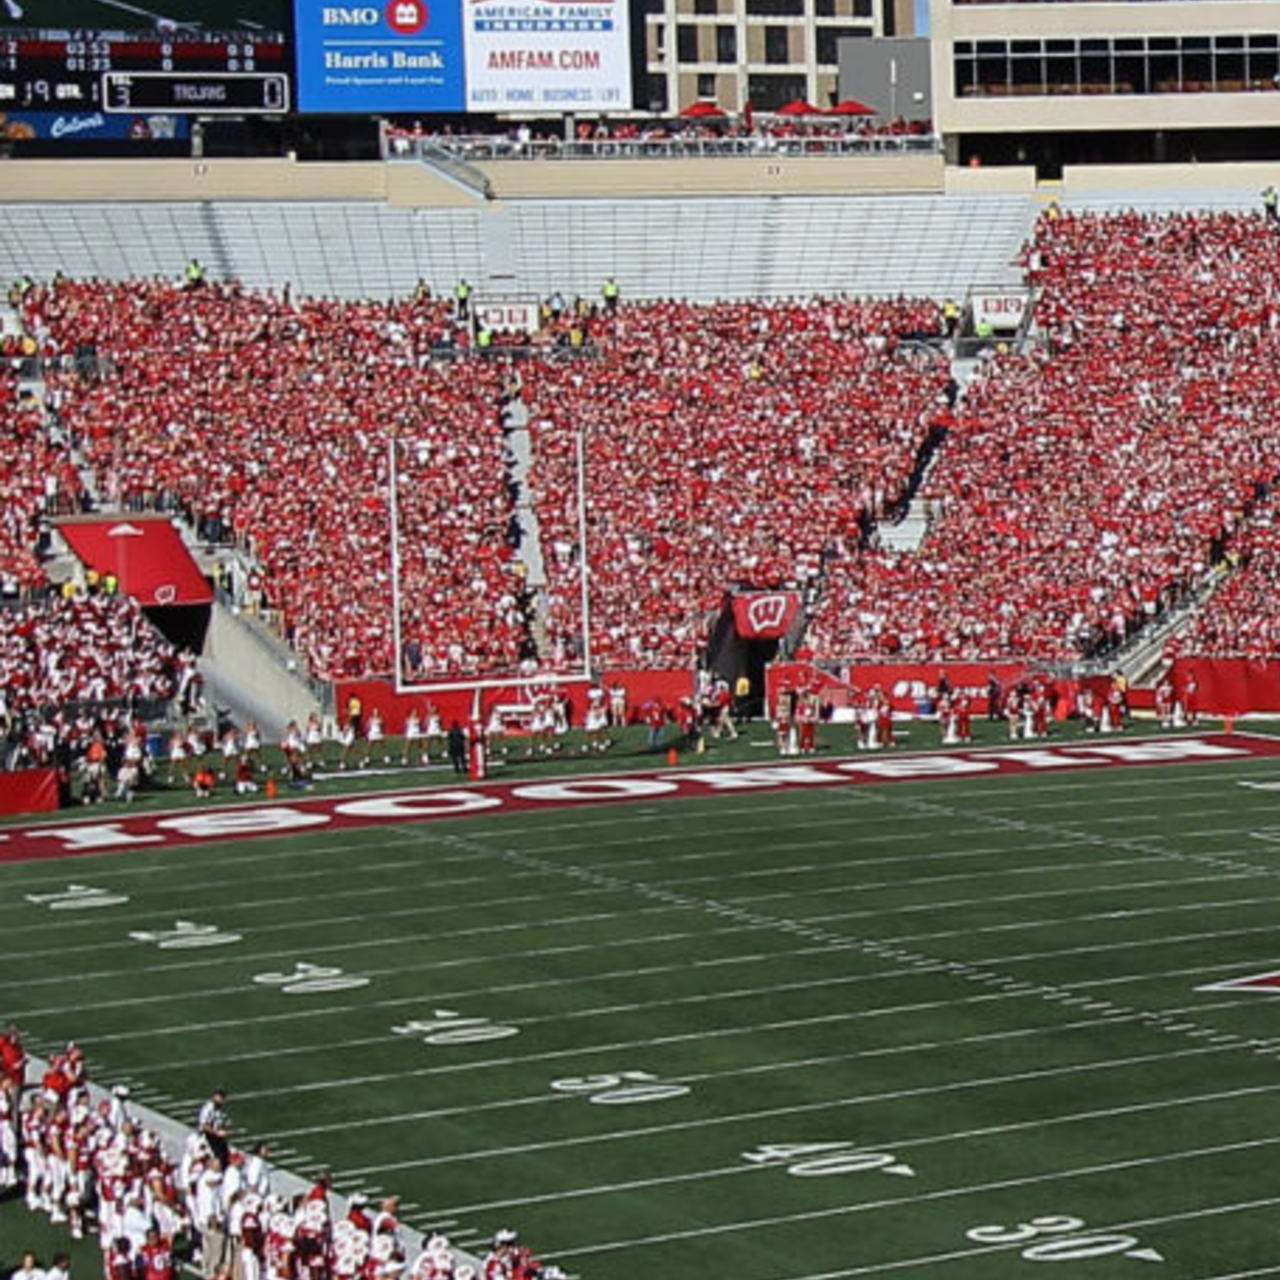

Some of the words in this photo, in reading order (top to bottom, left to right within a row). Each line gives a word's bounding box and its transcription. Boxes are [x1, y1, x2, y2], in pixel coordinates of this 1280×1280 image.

[322, 8, 378, 25] BMO
[474, 7, 549, 18] AMERICAN
[558, 7, 613, 18] FAMILY
[324, 52, 388, 68] Harris
[392, 52, 444, 68] Bank
[488, 51, 600, 70] AMFAM.COM
[0, 740, 1252, 849] ISCONSIN
[966, 1215, 1139, 1262] 30
